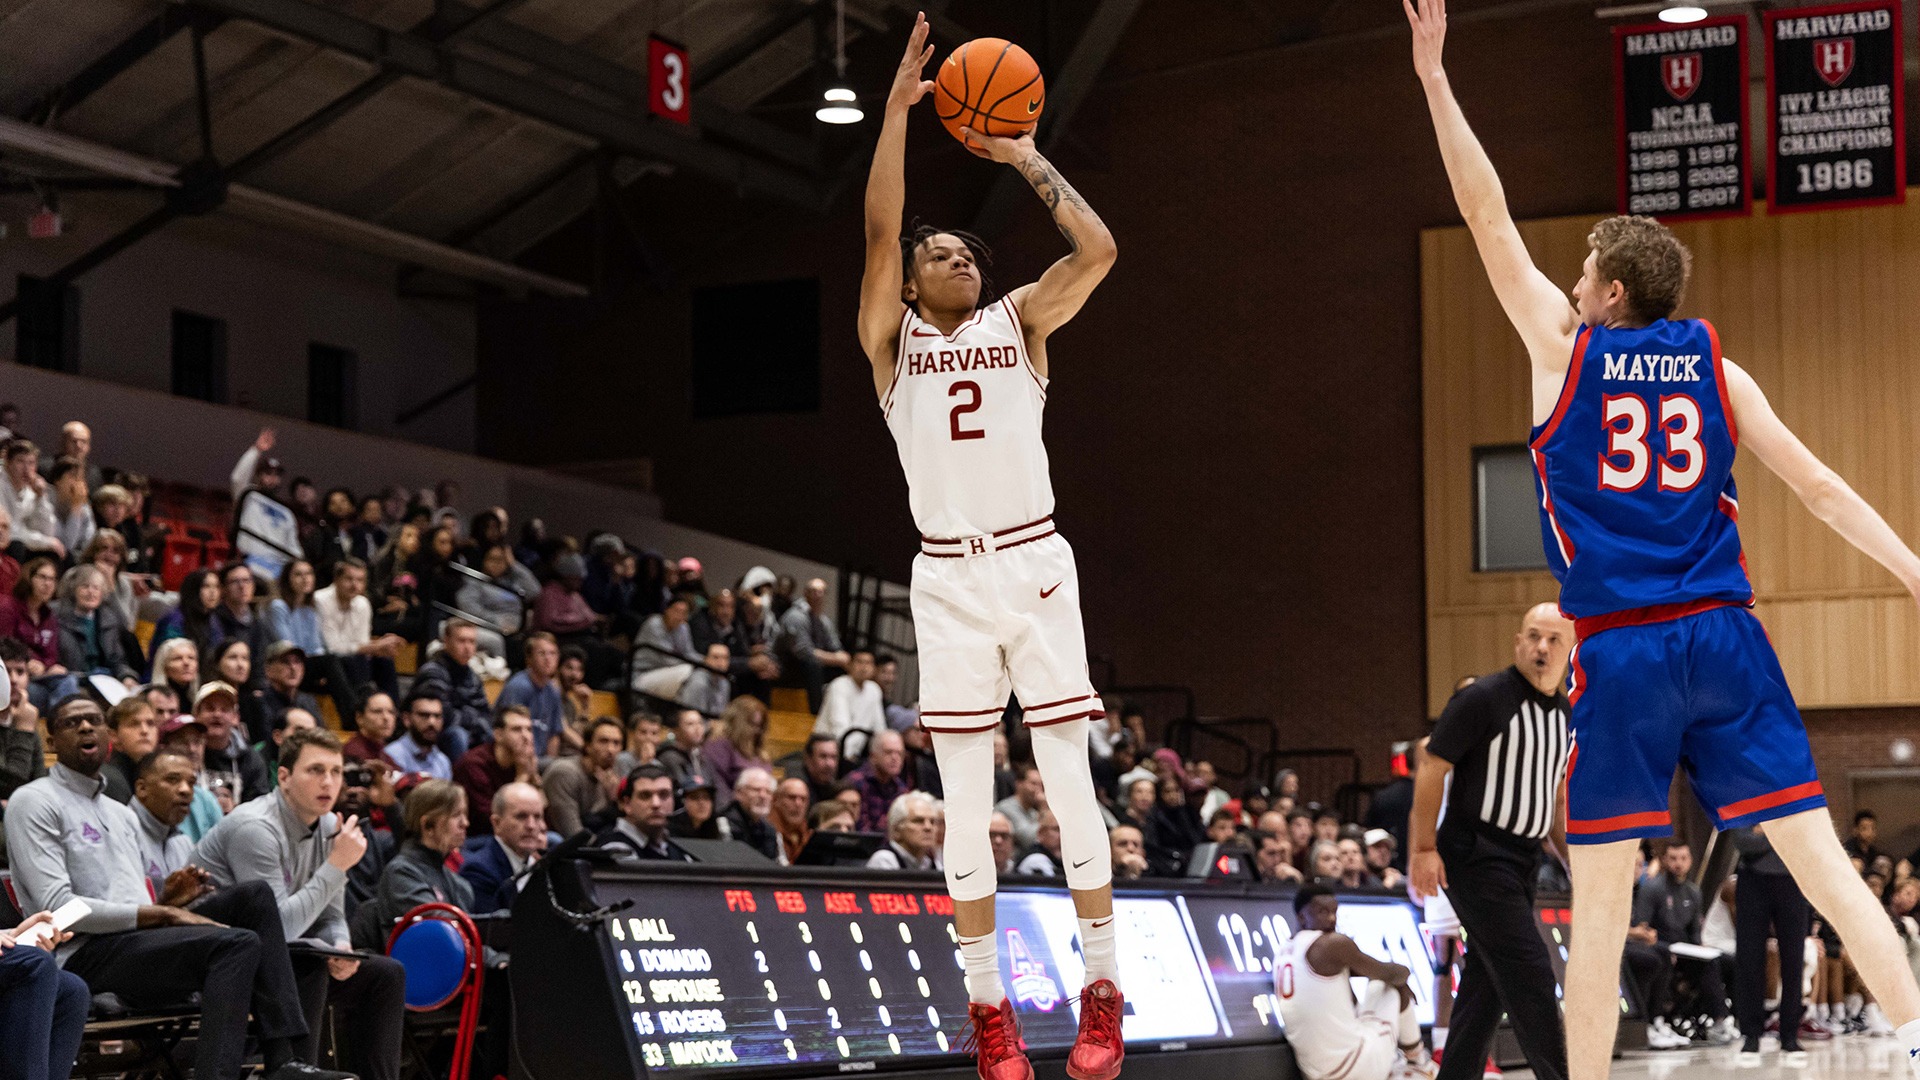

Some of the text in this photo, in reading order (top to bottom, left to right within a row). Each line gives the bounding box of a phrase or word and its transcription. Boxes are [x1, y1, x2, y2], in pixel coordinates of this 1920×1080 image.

[1776, 9, 1890, 40] HARVARD
[1626, 25, 1737, 56] HARVARD
[1823, 42, 1845, 74] H
[662, 52, 684, 111] 3
[1671, 58, 1692, 89] H
[1780, 84, 1890, 113] IVY LEAGUE
[1651, 103, 1713, 130] NCAA
[1779, 105, 1891, 134] TOURNAMENT
[1628, 122, 1738, 150] TOURNAMENT
[1779, 126, 1892, 156] CHAMPIONS
[1797, 158, 1873, 193] 1986
[1688, 185, 1739, 208] 2007
[908, 346, 1017, 376] HARVARD
[1603, 353, 1700, 382] MAYOCK
[948, 380, 985, 441] 2
[1597, 392, 1707, 493] 33
[970, 538, 985, 554] H
[724, 890, 756, 912] PTS
[774, 891, 807, 913] REB
[869, 893, 920, 915] STEALS
[613, 918, 625, 941] 4
[629, 918, 675, 941] BALL
[746, 921, 759, 943] 1
[798, 921, 812, 943] 3
[850, 922, 863, 943] 0
[899, 922, 912, 943] 0
[620, 949, 635, 972] 8
[638, 948, 712, 972] DONADIO
[754, 950, 769, 972] 2
[808, 950, 821, 972] 0
[860, 950, 872, 971] 0
[908, 949, 921, 970] 0
[623, 976, 930, 1003] 12 SPROUSE 3 0 0 0
[633, 1005, 940, 1035] 15 ROGERS 0 2 0 0
[642, 1031, 949, 1066] 33 MAYOCK 3 0 0 0
